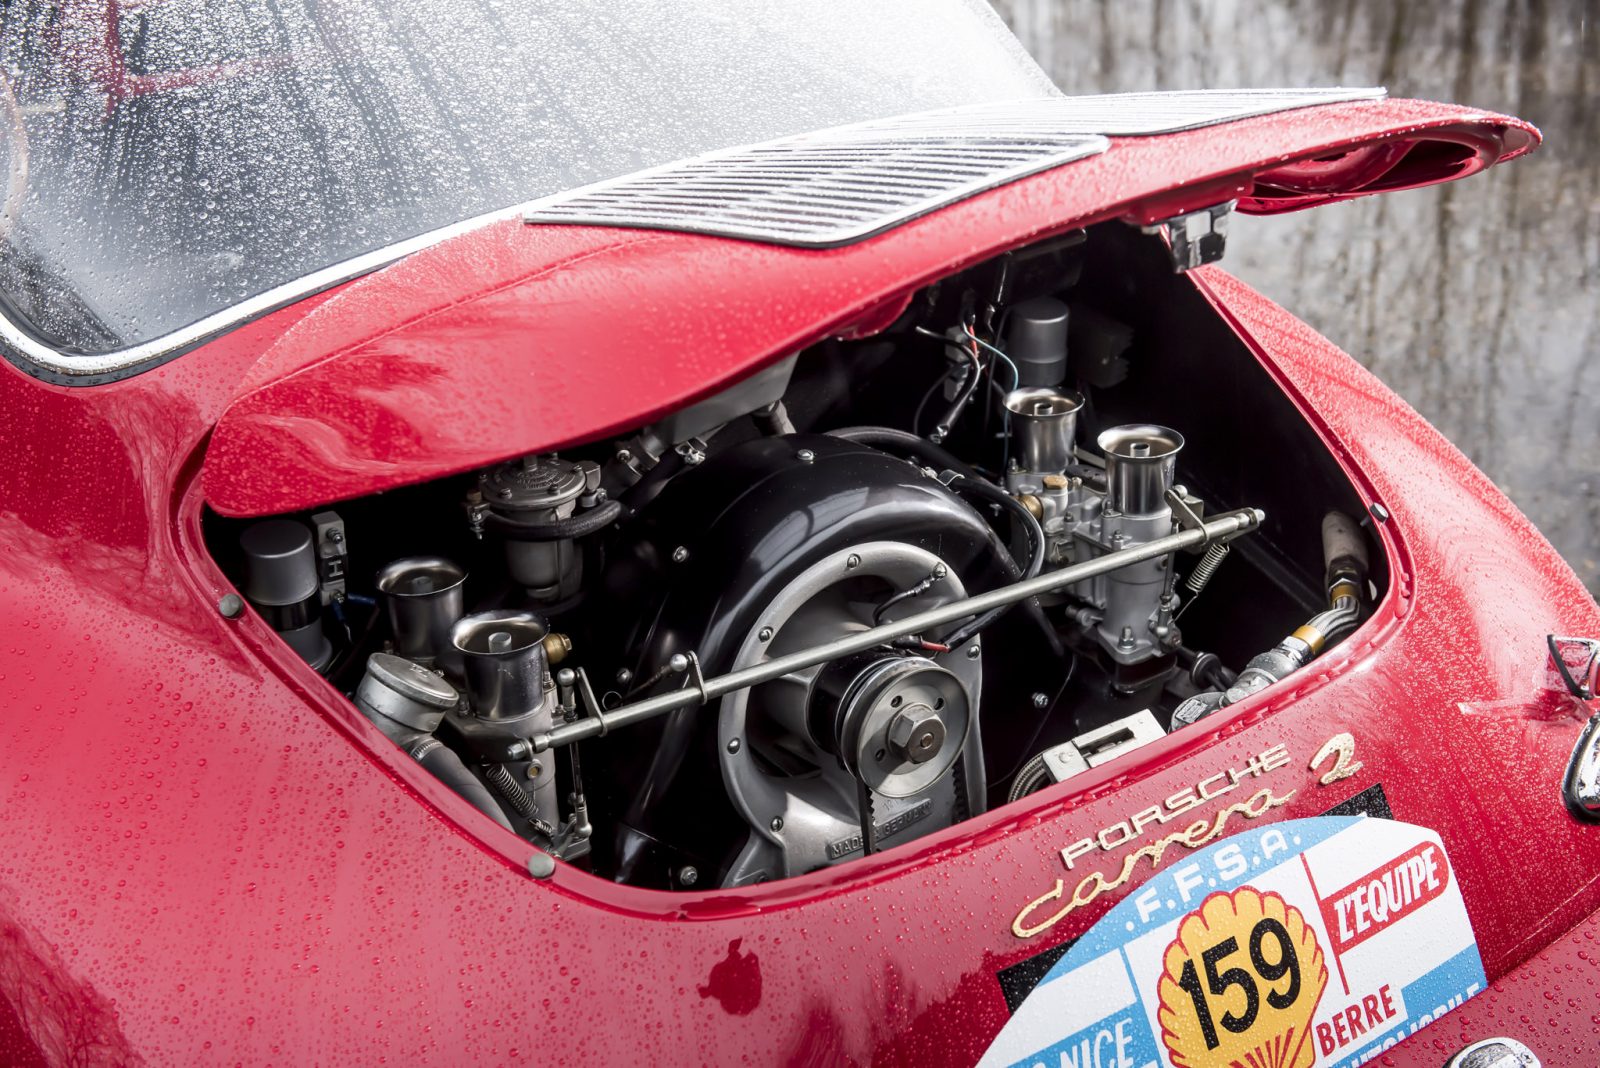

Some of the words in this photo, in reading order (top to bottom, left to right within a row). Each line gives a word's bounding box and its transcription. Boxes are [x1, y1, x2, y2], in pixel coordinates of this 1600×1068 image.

[1011, 788, 1297, 939] Carrera
[1308, 732, 1363, 786] 2
[1059, 742, 1292, 870] PORSCHE
[1178, 917, 1301, 1051] 159
[1316, 983, 1397, 1058] BERRE
